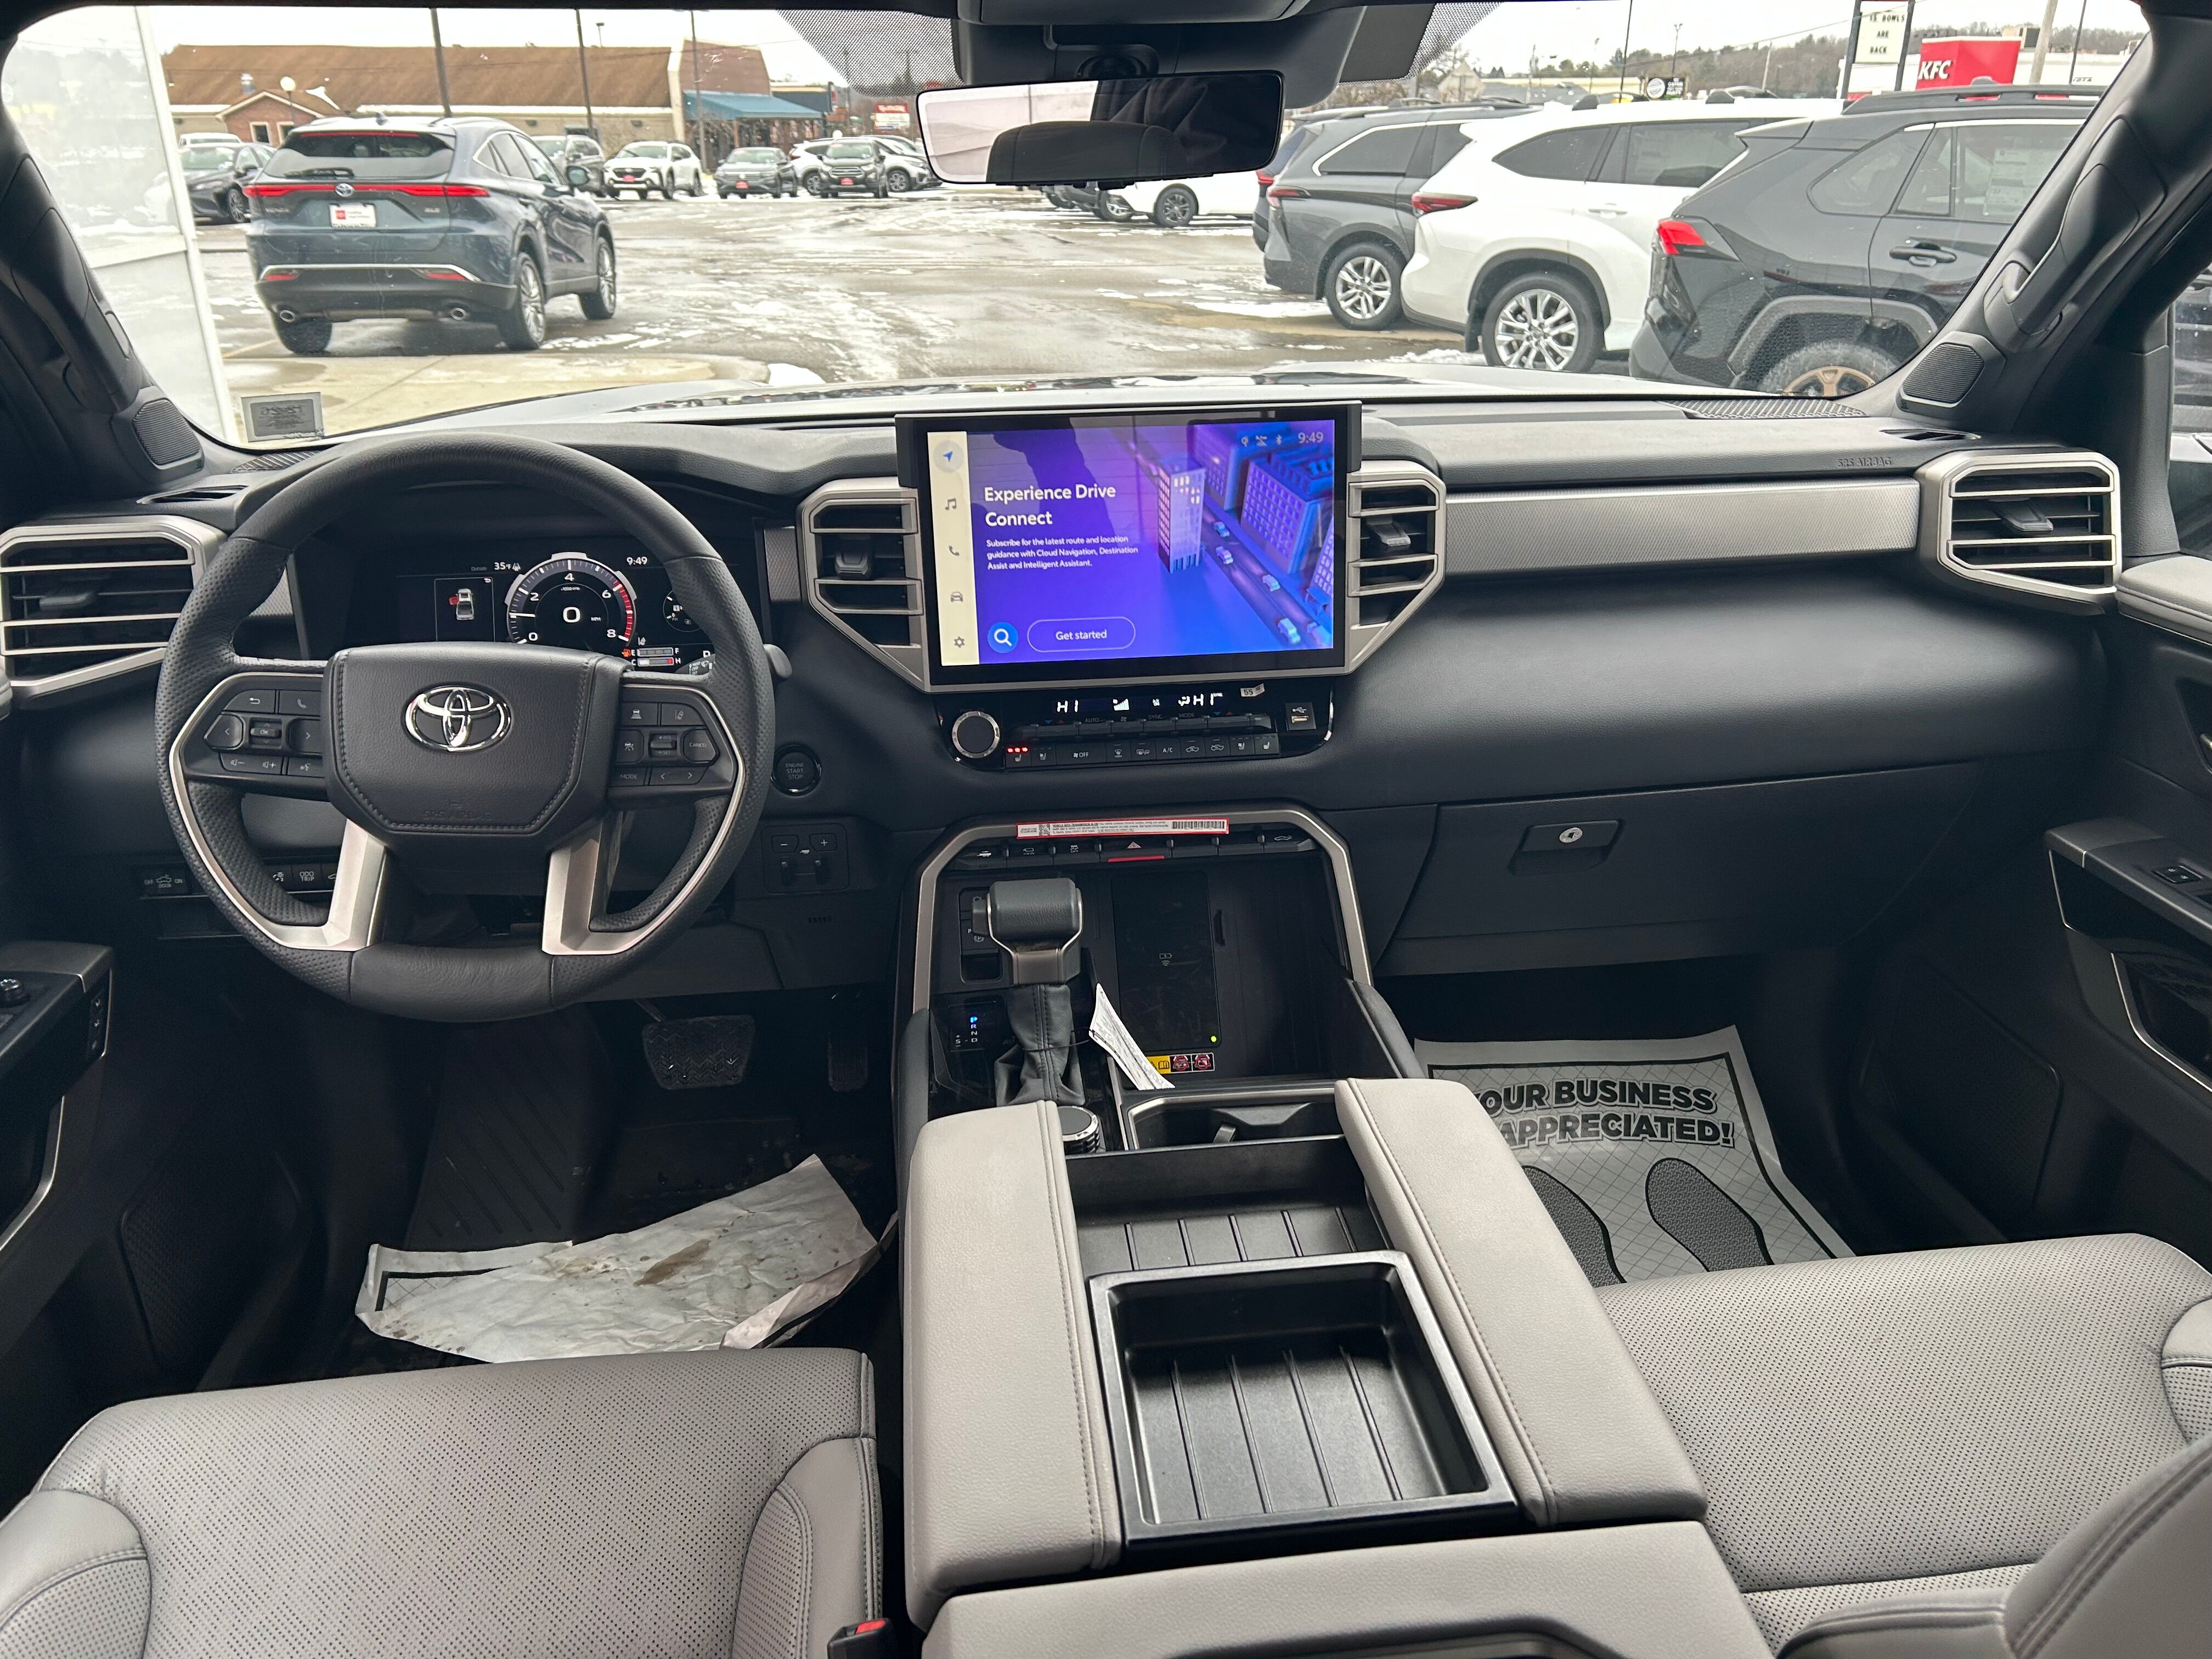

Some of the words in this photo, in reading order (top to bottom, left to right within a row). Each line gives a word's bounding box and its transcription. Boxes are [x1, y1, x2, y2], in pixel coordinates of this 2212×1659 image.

[1882, 14, 1905, 22] BOWLS
[1870, 46, 1888, 54] BACK
[1918, 60, 1952, 80] KFC
[1298, 432, 1323, 443] 9:49
[1838, 458, 1854, 467] SRS
[1857, 456, 1892, 466] AIRBAG
[984, 485, 1072, 504] Experience
[1075, 483, 1116, 499] Drive
[985, 511, 1053, 527] Connect
[986, 538, 1020, 548] Subscribe
[1045, 537, 1065, 545] latest
[1086, 535, 1099, 544] and
[1100, 535, 1128, 544] location
[987, 550, 1019, 560] guidance
[1020, 549, 1036, 558] with
[1036, 549, 1058, 557] Cloud
[1059, 547, 1098, 557] Navigation,
[1099, 545, 1138, 555] Destination
[627, 556, 647, 566] 9:49
[988, 561, 1008, 570] Assist
[1008, 561, 1023, 569] and
[1023, 560, 1059, 570] Intelligent
[1059, 558, 1093, 567] Assistant.
[565, 573, 574, 582] 4
[530, 592, 539, 601] 2
[602, 590, 611, 599] 6
[563, 607, 580, 623] 0
[528, 632, 538, 641] 0
[607, 629, 616, 638] 8
[1056, 631, 1073, 641] Get
[1075, 629, 1107, 640] started
[1057, 699, 1079, 713] HI
[1554, 1079, 1716, 1111] BUSINESS
[1500, 1114, 1734, 1148] APPRECIATED!
